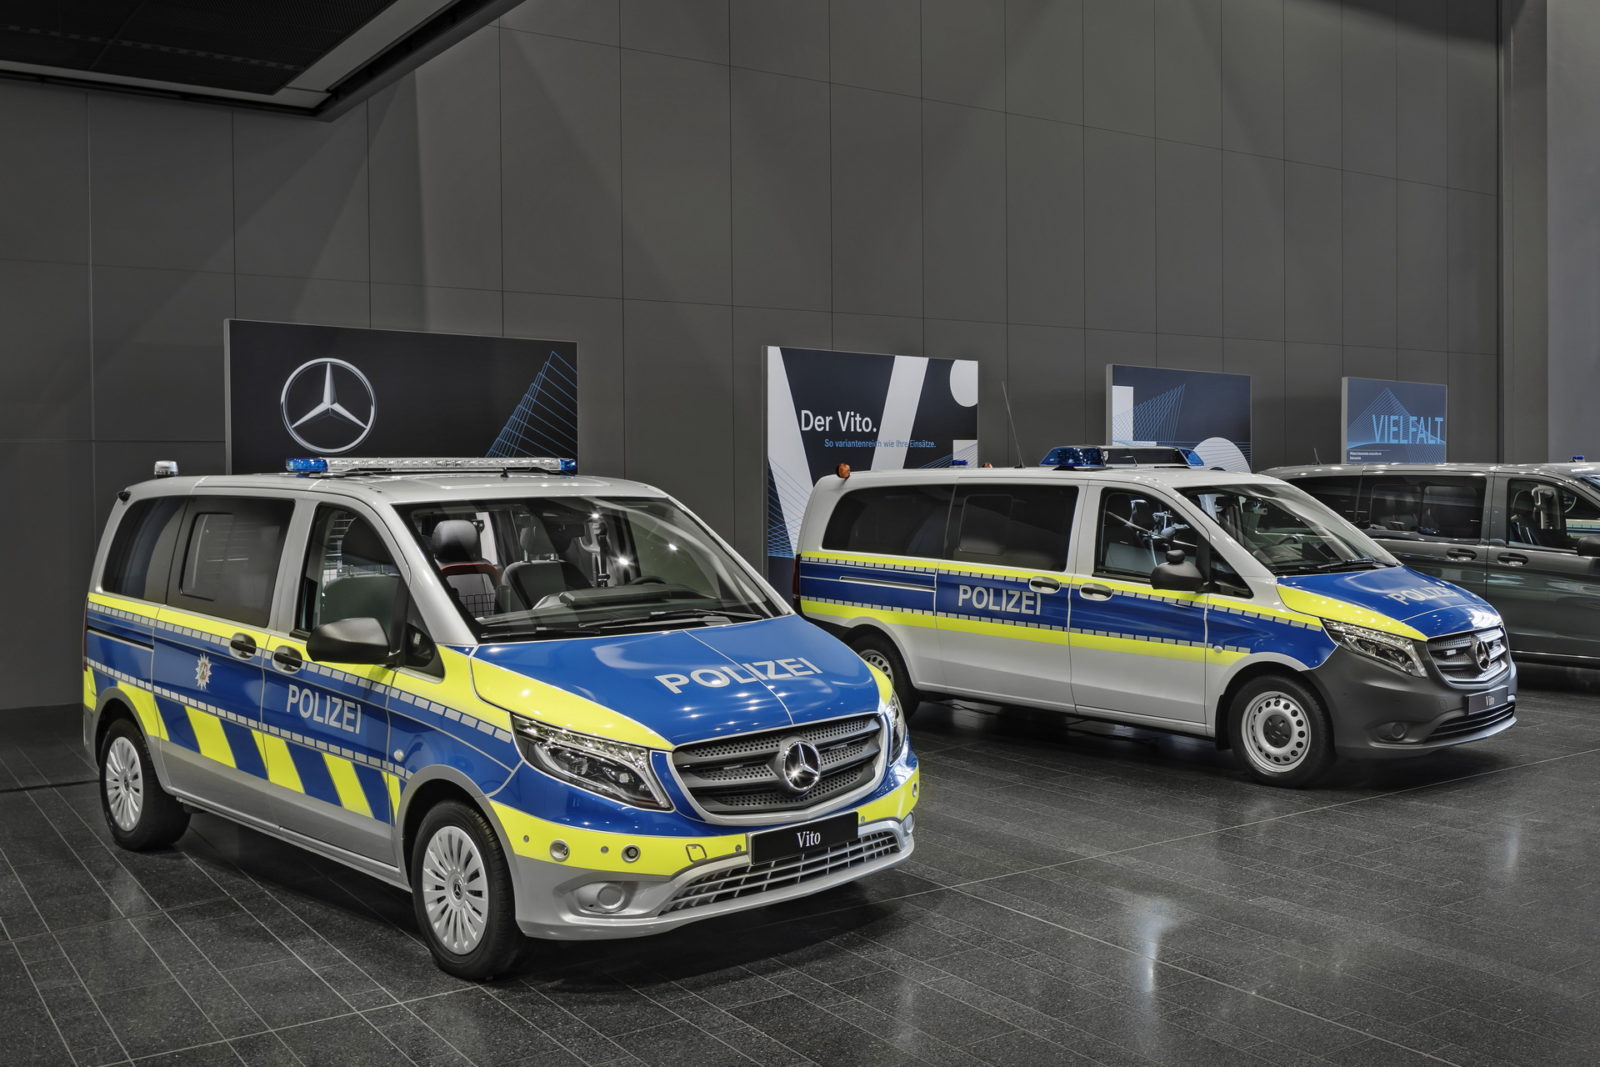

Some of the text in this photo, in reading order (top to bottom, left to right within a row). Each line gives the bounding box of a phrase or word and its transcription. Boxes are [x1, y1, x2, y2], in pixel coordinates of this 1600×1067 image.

[801, 410, 877, 432] Der Vito.
[1372, 414, 1444, 444] VIELFALT
[824, 439, 834, 448] So
[835, 439, 882, 448] variantenreich
[884, 440, 895, 448] wie
[910, 439, 937, 448] Einsätze.
[958, 585, 1042, 615] POLIZEI
[654, 657, 823, 694] POLIZEI
[286, 684, 362, 734] POLIZEI
[797, 831, 821, 847] Vito
